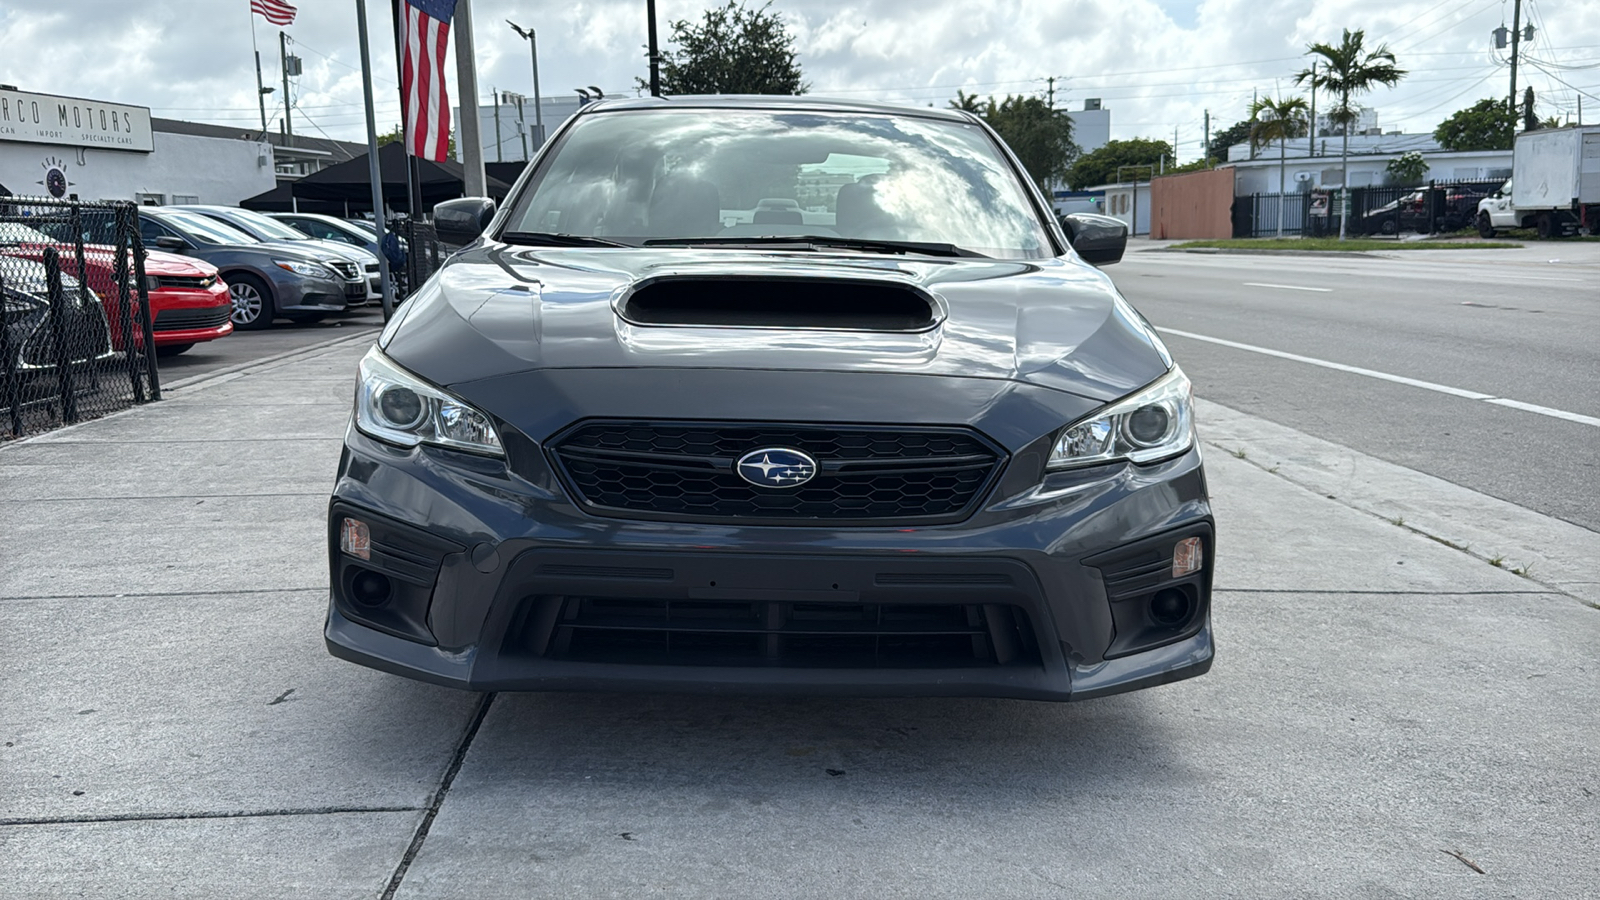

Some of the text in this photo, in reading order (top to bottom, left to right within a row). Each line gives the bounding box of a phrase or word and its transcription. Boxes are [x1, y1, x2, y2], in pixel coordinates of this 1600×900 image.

[2, 97, 131, 133] RCO MOTORS
[36, 129, 63, 138] IMPORT
[81, 133, 114, 143] SPECIALTY
[117, 137, 133, 145] CARS
